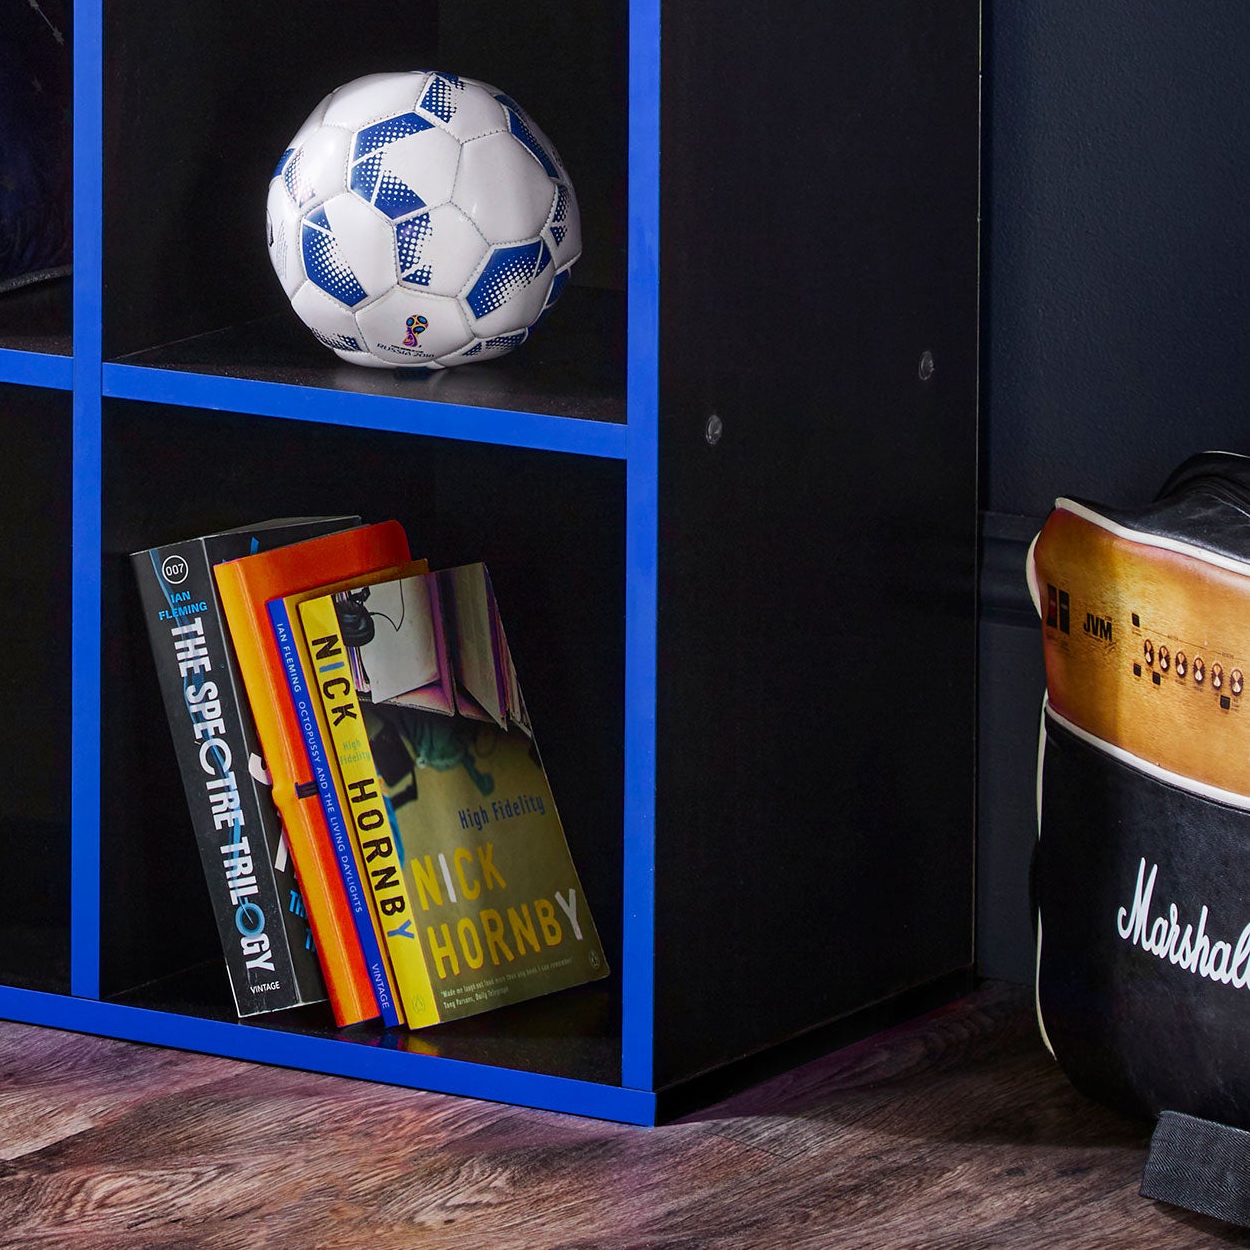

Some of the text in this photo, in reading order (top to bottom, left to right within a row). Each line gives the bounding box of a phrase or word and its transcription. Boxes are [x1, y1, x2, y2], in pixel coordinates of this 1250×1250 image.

[377, 343, 411, 356] RUSSIA
[165, 563, 184, 577] 007
[158, 601, 208, 621] FLEMING
[170, 591, 191, 603] IAN
[171, 617, 212, 678] THE
[1083, 613, 1112, 641] JVM
[186, 681, 245, 830] SPECTRE
[276, 623, 363, 913] IAN FLEMING OCTOPUSSY AND THE LIVING DAYLIGHTS
[311, 634, 415, 939] NICK HORNBY
[458, 794, 546, 831] High Fidelity
[410, 842, 507, 911] NICK
[220, 836, 276, 971] TRILOGY
[1117, 857, 1250, 991] Marshal
[427, 888, 584, 980] HORNBY
[250, 981, 281, 995] VINTAGE
[372, 963, 390, 1009] VINTAGE
